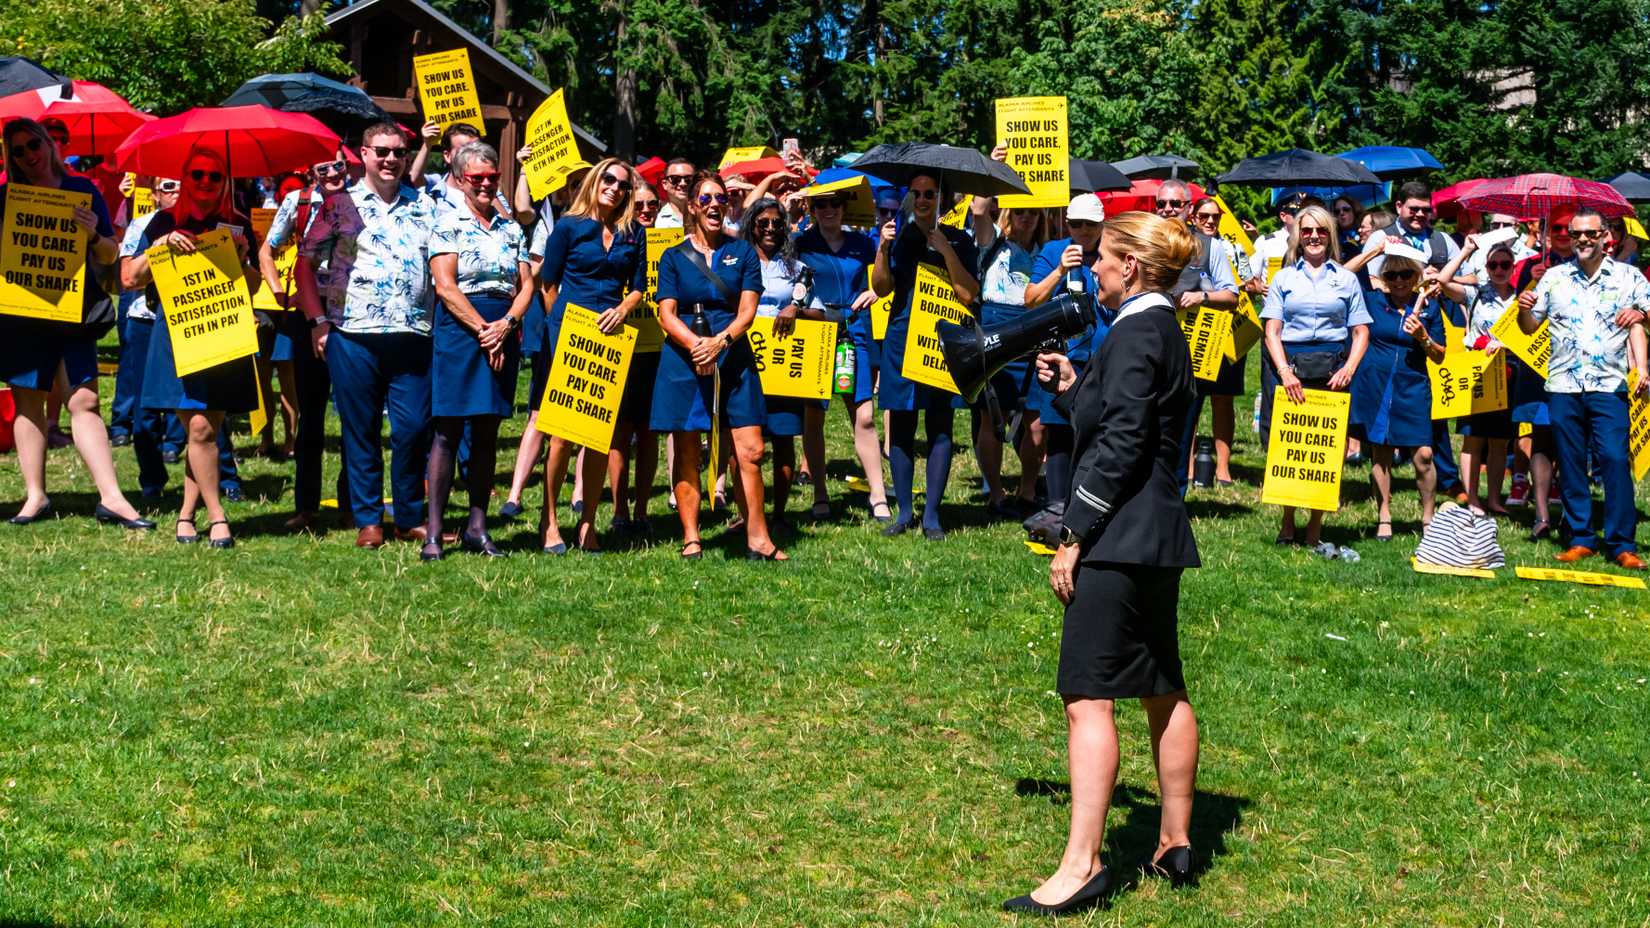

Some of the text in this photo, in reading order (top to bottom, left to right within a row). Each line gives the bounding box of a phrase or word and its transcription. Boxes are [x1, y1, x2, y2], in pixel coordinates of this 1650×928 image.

[424, 69, 464, 84] SHOW US
[425, 86, 442, 98] YOU
[435, 96, 464, 110] PAY US
[448, 108, 478, 121] SHARE
[545, 118, 552, 128] IN
[1006, 120, 1058, 132] SHOW US
[530, 124, 564, 149] ASSENGER
[1005, 136, 1061, 150] YOU CARE,
[533, 148, 570, 172] 6TH IN PAY
[1014, 153, 1052, 166] PAY US
[1028, 170, 1065, 182] SHARE
[16, 212, 78, 234] SHOW US
[12, 232, 78, 254] YOU CARE,
[21, 252, 66, 272] PAY US
[6, 270, 78, 293] OUR SHARE
[182, 268, 216, 286] 1ST IN
[172, 280, 236, 308] PASSENGER
[919, 281, 934, 296] WE
[184, 313, 240, 339] 6TH IN PAY
[568, 334, 622, 365] SHOW US
[1192, 312, 1215, 373] WE DEMAND
[772, 348, 786, 365] OR
[789, 338, 805, 378] PAY US
[562, 351, 618, 386] YOU CARE,
[566, 374, 606, 400] PAY US
[1438, 368, 1456, 408] CHAOS
[1458, 378, 1468, 391] OR
[1472, 365, 1484, 400] PAY US
[549, 388, 612, 424] OUR SHARE
[1282, 412, 1338, 430] SHOW US
[1280, 430, 1336, 448] YOU CARE,
[1286, 448, 1326, 464] PAY US
[1272, 464, 1336, 484] OUR SHARE
